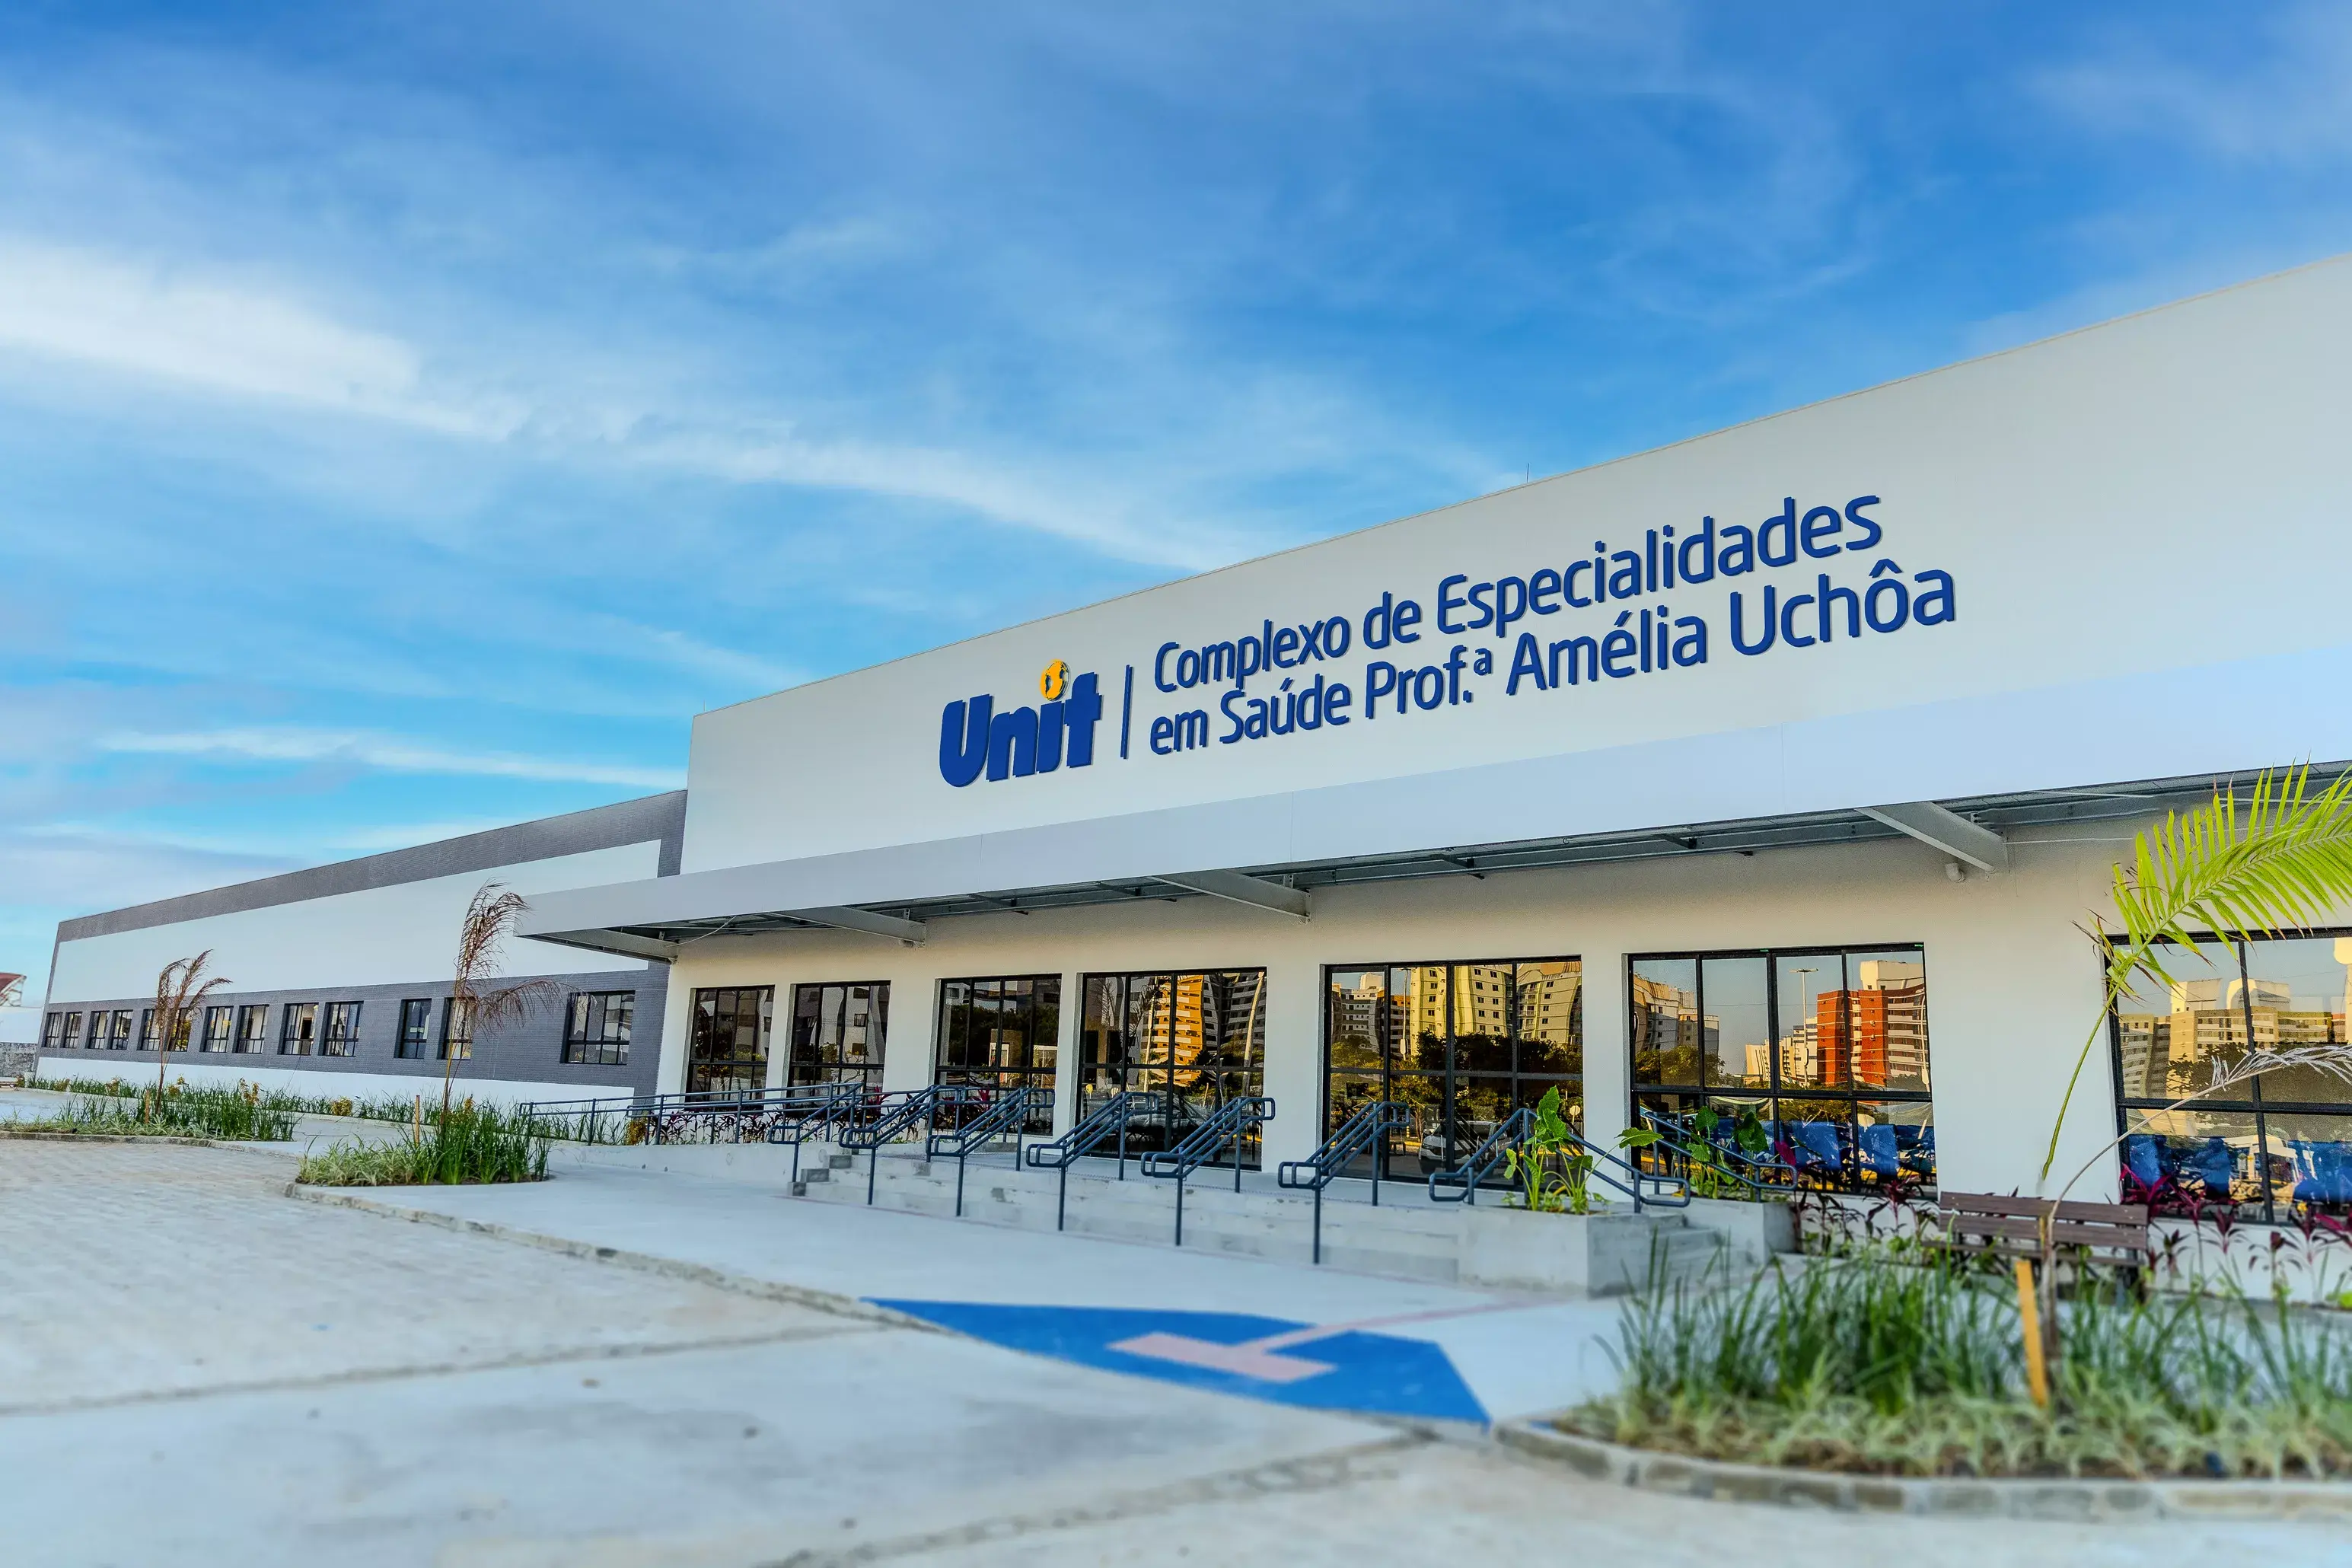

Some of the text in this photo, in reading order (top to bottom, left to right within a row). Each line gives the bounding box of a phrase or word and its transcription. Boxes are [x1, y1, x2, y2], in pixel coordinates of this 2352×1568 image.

[1150, 558, 1956, 756] em Saúde Prof.ª Amélia Uchôa
[1155, 495, 1883, 693] Complexo de Especialidades
[939, 659, 1102, 787] Unit
